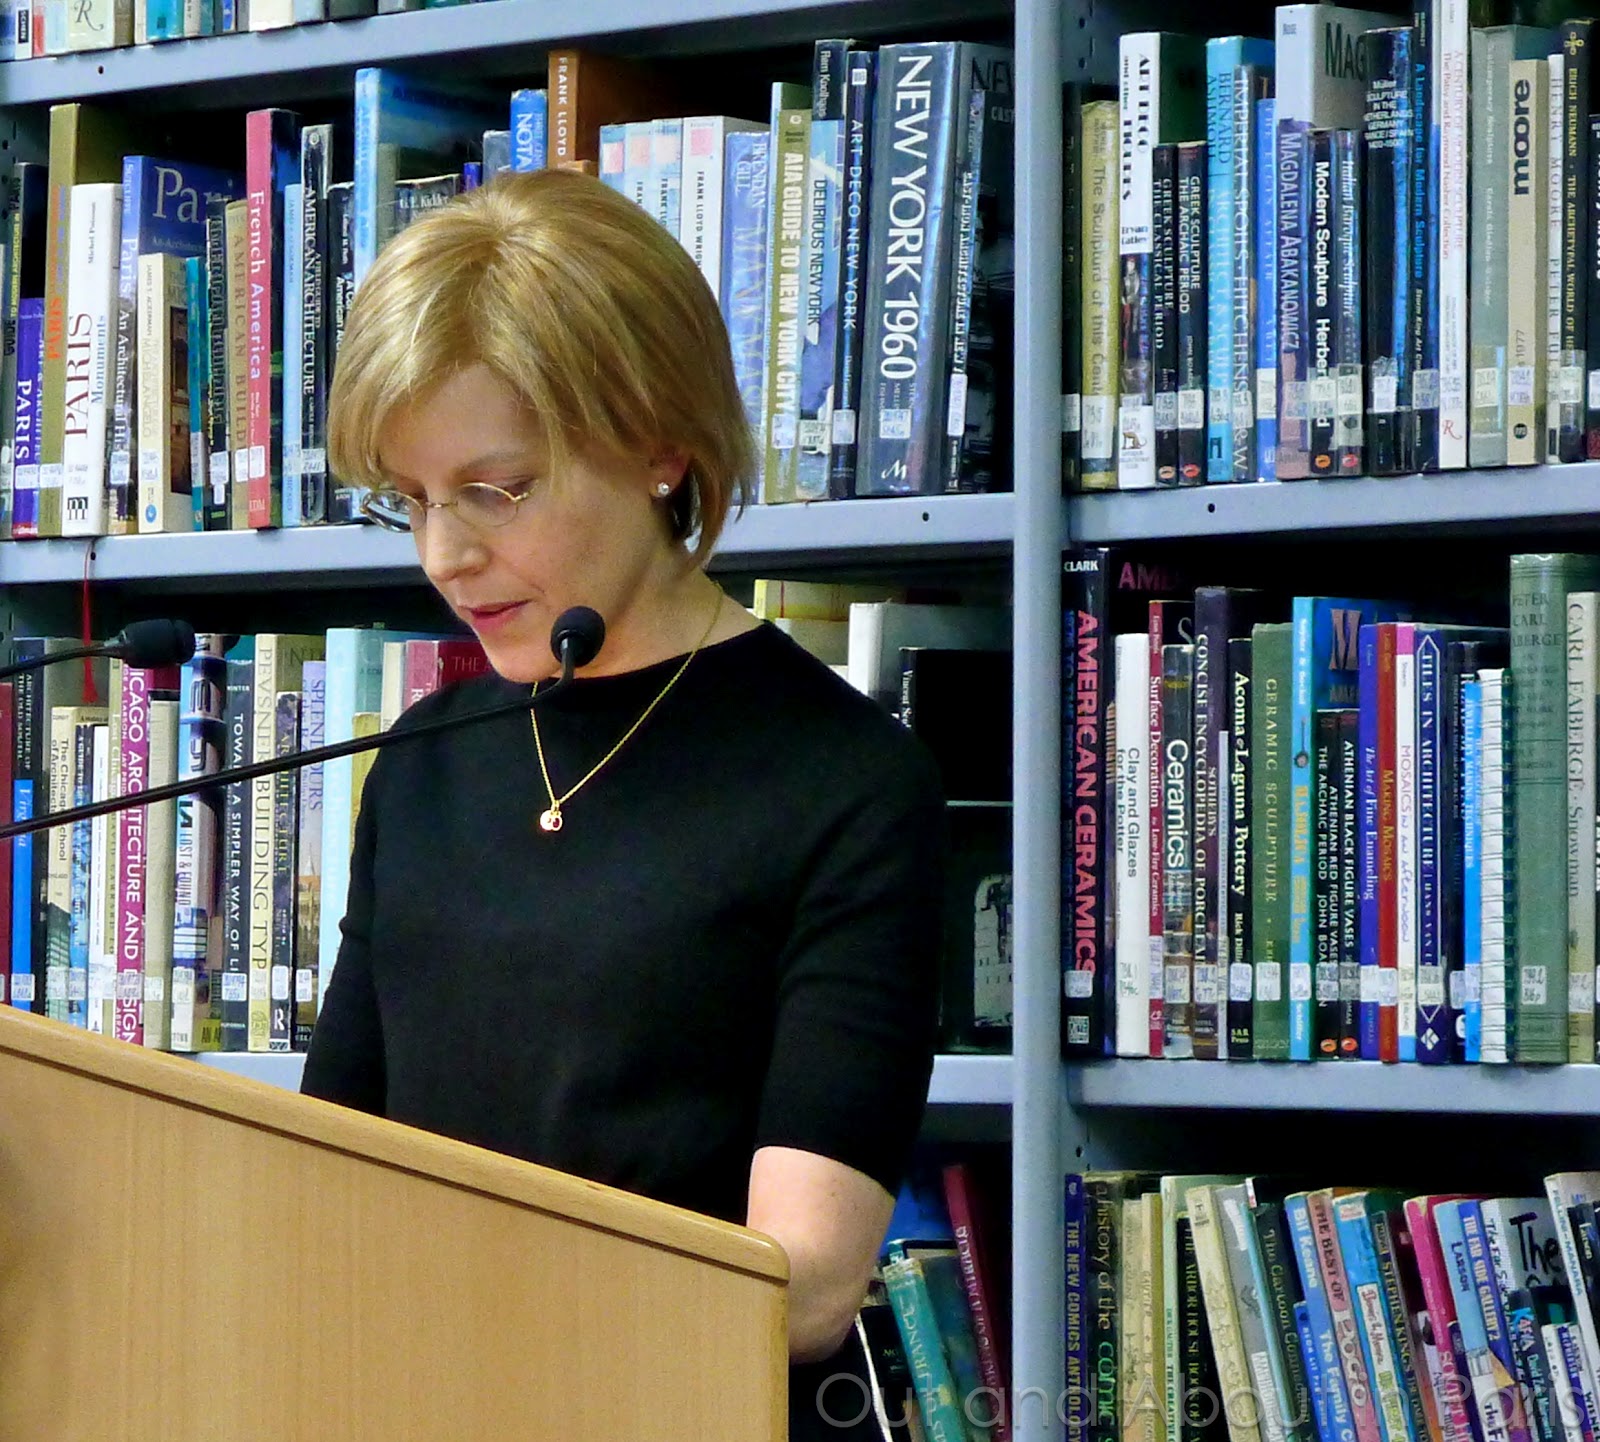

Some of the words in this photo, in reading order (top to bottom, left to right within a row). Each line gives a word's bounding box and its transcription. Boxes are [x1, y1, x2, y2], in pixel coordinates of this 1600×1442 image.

[557, 57, 568, 105] FRANK
[820, 50, 831, 72] Rem
[1442, 73, 1452, 98] Patsy
[1568, 67, 1578, 101] ERICH
[818, 74, 831, 118] Koolhaas
[893, 54, 934, 160] NEW
[1218, 72, 1232, 164] BERNARD
[1413, 76, 1426, 142] Landscape
[1550, 77, 1563, 142] HENRY
[557, 111, 568, 157] LLOYD
[850, 119, 863, 156] ART
[1234, 79, 1249, 171] IMPERIAL
[1441, 121, 1452, 168] Raymond
[1513, 79, 1531, 196] moore
[1568, 105, 1578, 157] NEUMANN
[736, 160, 751, 193] GILL
[752, 142, 767, 209] BRENDAN
[783, 152, 804, 183] AIA
[1092, 165, 1107, 196] The
[1415, 147, 1426, 163] for
[659, 177, 668, 207] FRANK
[696, 170, 705, 200] FRANK
[847, 165, 862, 218] DECO
[1162, 178, 1174, 225] GREEK
[1179, 177, 1190, 202] THE
[1190, 176, 1201, 216] GREEK
[1279, 132, 1302, 231] MAGDALENA
[1315, 161, 1330, 225] Modern
[1415, 168, 1426, 216] Modern
[1550, 156, 1562, 228] MOORE
[1567, 174, 1577, 198] THE
[250, 190, 266, 273] French
[304, 187, 316, 269] AMERICAN
[695, 203, 704, 232] LLOYD
[781, 186, 803, 242] GUIDE
[811, 179, 828, 249] DELIRIOUS
[886, 164, 928, 285] YORK
[1179, 206, 1190, 262] ARCHAIC
[1234, 188, 1249, 260] SPOILS
[119, 237, 138, 289] Paris
[780, 245, 802, 269] TO
[809, 253, 824, 289] NEW
[846, 227, 860, 271] NEW
[1153, 212, 1163, 291] CLASSICAL
[1163, 228, 1175, 310] SCULPTURE
[1190, 218, 1201, 289] SCULPTURE
[1311, 228, 1330, 307] Sculpture
[1413, 220, 1426, 278] Sculpture
[778, 273, 800, 315] NEW
[807, 291, 822, 326] YORK
[843, 277, 858, 330] YORK
[1179, 267, 1190, 314] PERIOD
[1281, 234, 1303, 350] ABAKANOWICZ
[1414, 288, 1423, 314] Storm
[1549, 258, 1559, 318] PETER
[1566, 273, 1576, 312] WORLD
[118, 310, 128, 330] An
[250, 283, 266, 379] America
[303, 271, 315, 395] ARCHITECTURE
[776, 318, 799, 367] YORK
[880, 291, 920, 379] 1960
[1154, 294, 1164, 350] PERIOD
[1234, 275, 1249, 392] HITCHENS
[1413, 315, 1423, 336] King
[65, 313, 92, 440] PARIS
[91, 315, 106, 404] Monuments
[114, 333, 128, 421] Architectural
[775, 371, 797, 412] CITY
[15, 379, 33, 459] PARIS
[1064, 560, 1099, 572] CLARK
[1568, 603, 1584, 671] CARL
[902, 669, 913, 705] Vincent
[1195, 633, 1208, 708] CONCISE
[1421, 652, 1434, 702] TILES
[1076, 609, 1099, 797] AMERICAN
[1150, 675, 1161, 727] Surface
[1234, 670, 1250, 737] Acoma
[1265, 678, 1278, 770] CERAMIC
[60, 738, 69, 762] The
[1116, 748, 1126, 769] for
[1318, 746, 1328, 769] THE
[1365, 746, 1376, 765] The
[1568, 680, 1586, 791] FABERGÉ
[1116, 774, 1127, 801] the
[1126, 747, 1140, 784] Clay
[1150, 730, 1161, 808] Decoration
[1194, 713, 1208, 844] ENCYCLOPEDIA
[1230, 748, 1250, 820] Laguna
[1343, 740, 1355, 810] ATHENIAN
[1365, 768, 1376, 784] Art
[1400, 745, 1413, 813] MOSAICS
[232, 794, 243, 805] A
[1127, 787, 1140, 819] and
[1166, 739, 1189, 869] Ceramics
[1207, 766, 1217, 837] SOTHEBY'S
[1318, 773, 1328, 829] ARCHAIC
[1329, 785, 1339, 852] ATHENIAN
[1365, 798, 1378, 827] Fine
[1382, 769, 1394, 822] MAKING
[1421, 737, 1434, 871] ARCHITECTURE
[230, 812, 242, 878] SIMPLER
[253, 779, 271, 910] BUILDING
[1116, 803, 1127, 854] Potter
[1127, 821, 1140, 878] Glazes
[1151, 828, 1160, 870] Low-Fire
[1265, 782, 1278, 902] SCULPTURE
[1344, 813, 1354, 855] BLACK
[1383, 825, 1395, 881] MOSAICS
[1568, 806, 1584, 898] Snowman
[1194, 848, 1206, 870] OF
[1231, 825, 1249, 897] Pottery
[1318, 833, 1328, 880] PERIOD
[1329, 855, 1338, 881] RED
[1344, 858, 1354, 906] FIGURE
[1363, 830, 1378, 901] Enameling
[229, 885, 241, 922] WAY
[1075, 804, 1097, 973] CERAMICS
[1151, 872, 1160, 917] Ceramics
[1317, 894, 1328, 929] JOHN
[1329, 883, 1338, 928] FIGURE
[123, 910, 140, 960] AND
[230, 928, 240, 951] OF
[1234, 912, 1244, 935] Rick
[1344, 910, 1354, 948] VASES
[1067, 1220, 1080, 1248] THE
[1090, 1199, 1117, 1265] history
[1293, 1208, 1307, 1232] Bil
[1509, 1210, 1562, 1275] The
[1578, 1222, 1594, 1261] Larson
[1067, 1253, 1080, 1288] NEW
[1096, 1271, 1114, 1293] of
[1298, 1234, 1318, 1289] Keane
[1319, 1234, 1338, 1279] BEST
[1331, 1280, 1346, 1304] OF
[1450, 1241, 1470, 1292] LARSON
[1463, 1215, 1479, 1240] THE
[1478, 1286, 1498, 1331] GALLERY
[1066, 1291, 1081, 1352] COMICS
[1097, 1295, 1115, 1330] the
[1066, 1355, 1081, 1442] ANTHOLOGY
[1096, 1341, 1116, 1425] comic
